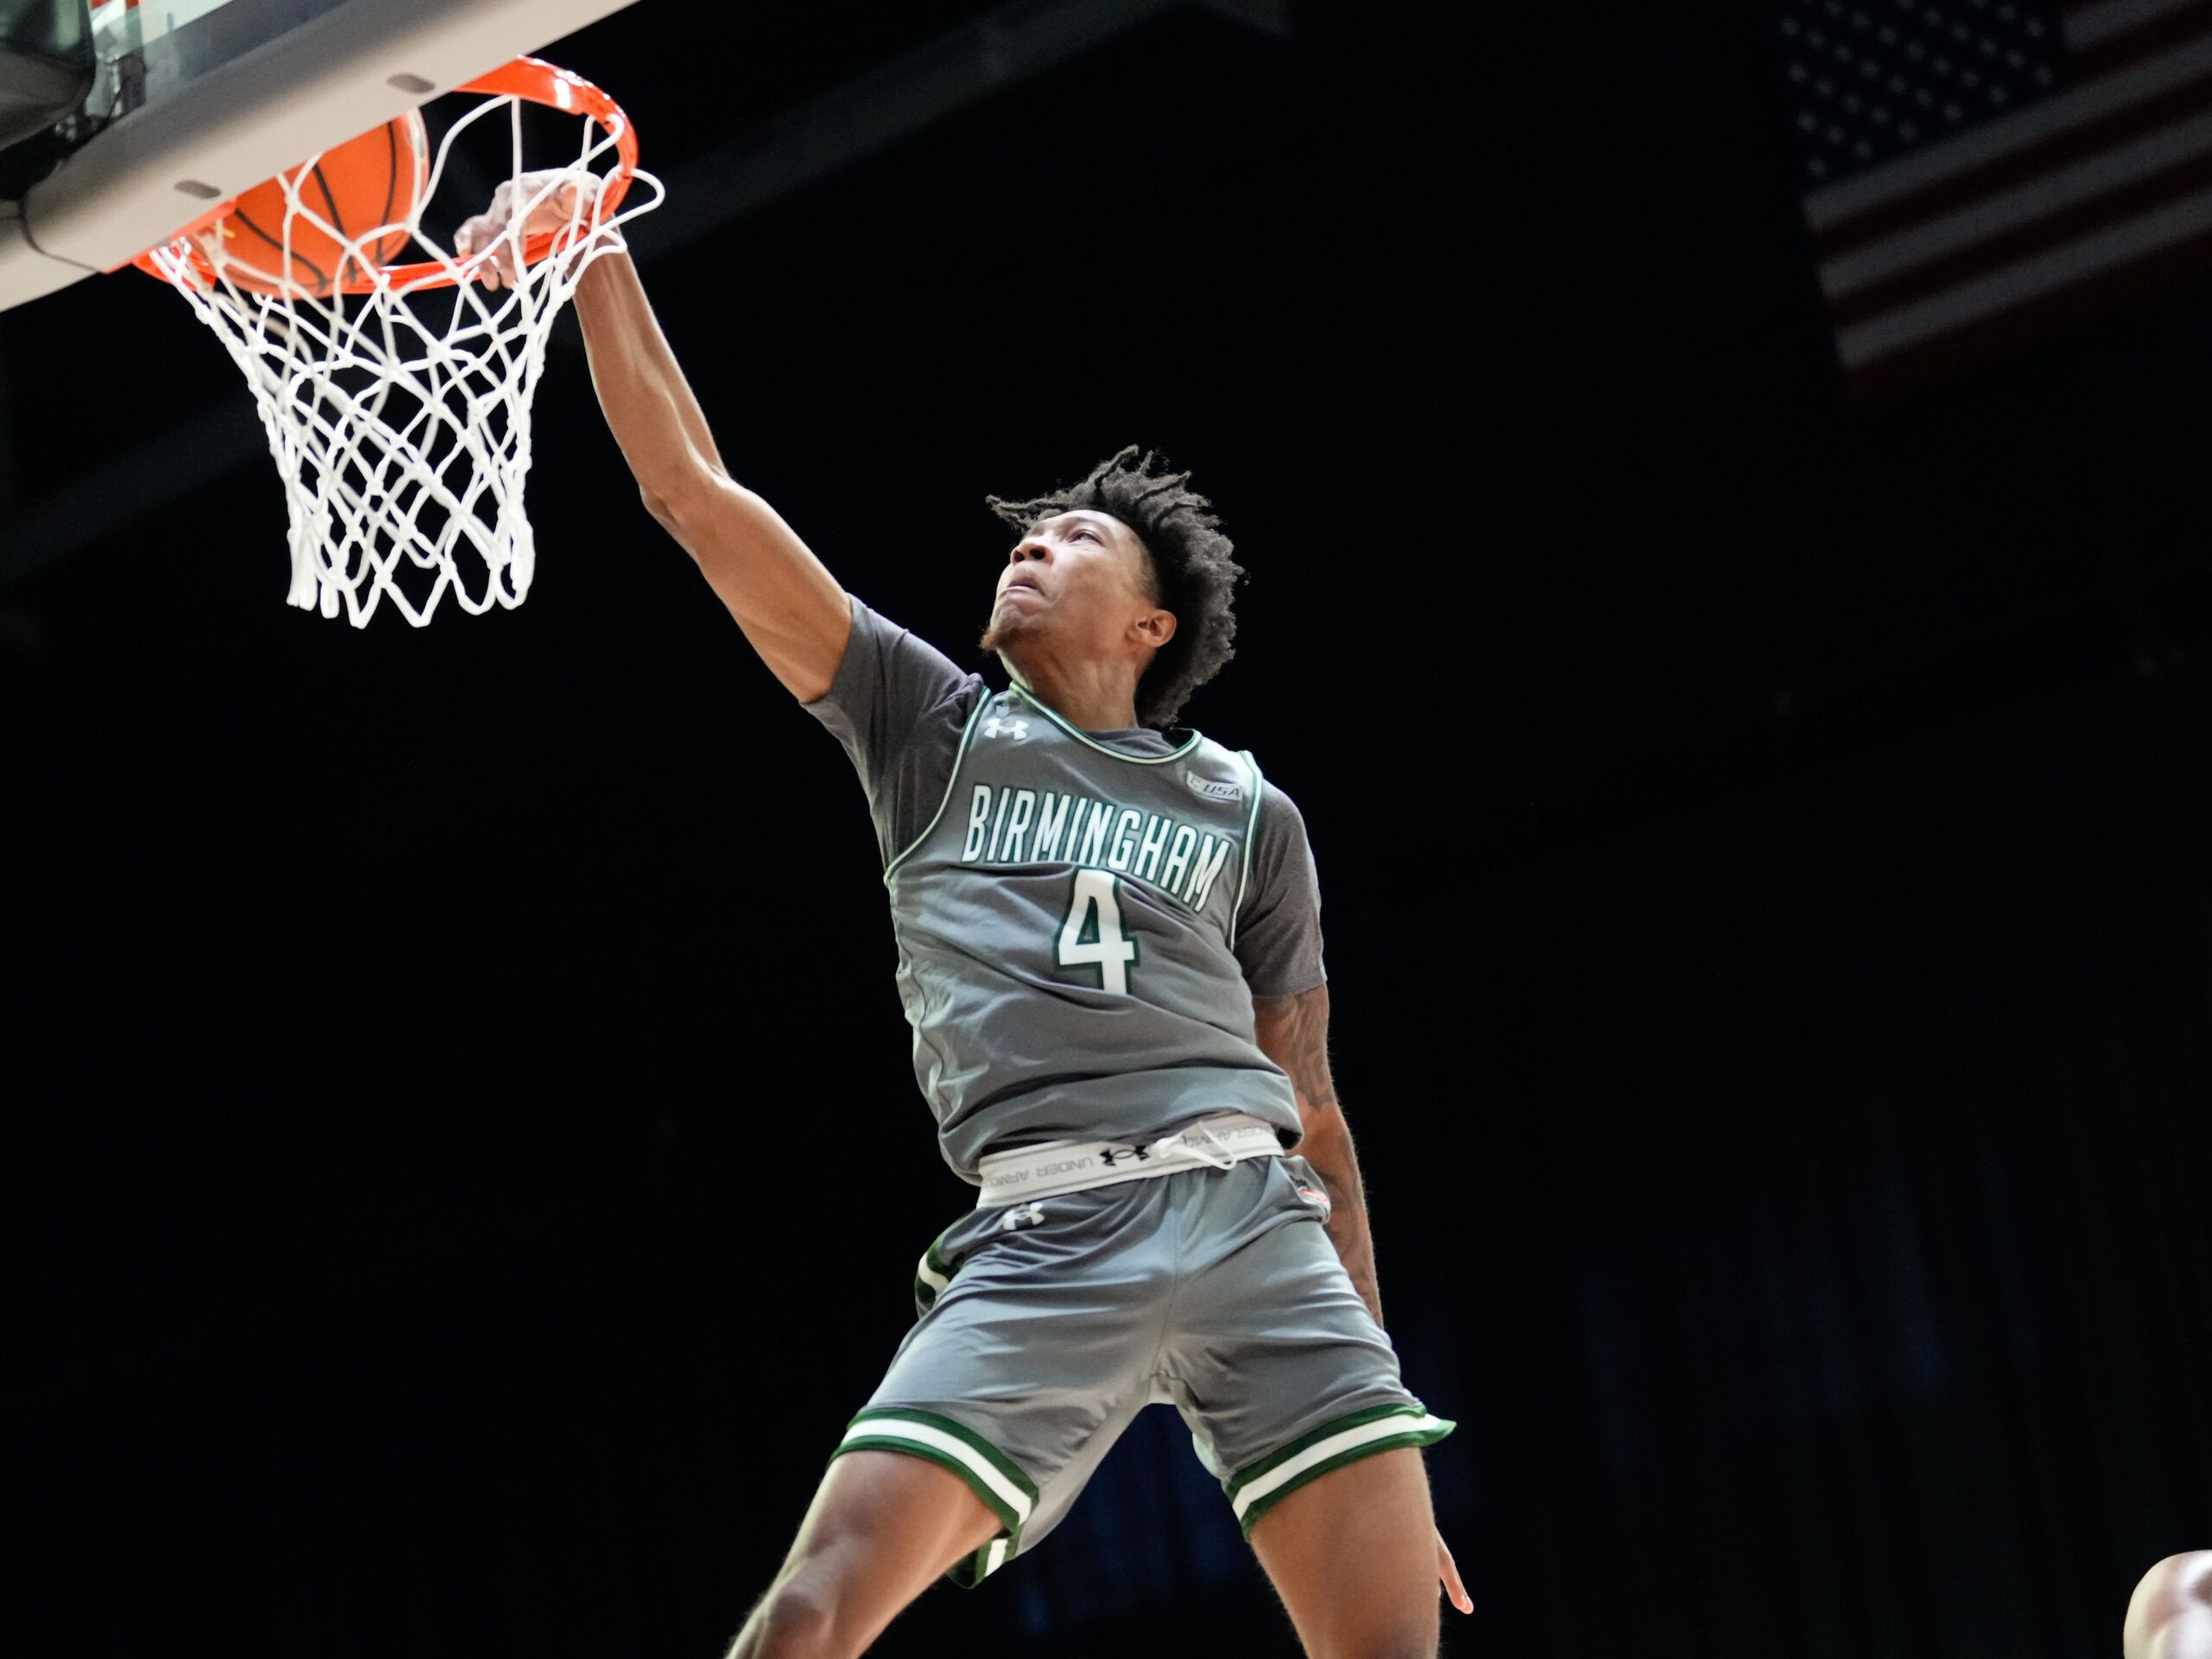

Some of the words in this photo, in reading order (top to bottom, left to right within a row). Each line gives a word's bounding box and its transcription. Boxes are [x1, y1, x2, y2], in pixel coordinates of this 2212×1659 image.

[961, 783, 1231, 913] BIRMINGHAM
[1056, 867, 1138, 995] 4
[1036, 1156, 1095, 1177] UNDER
